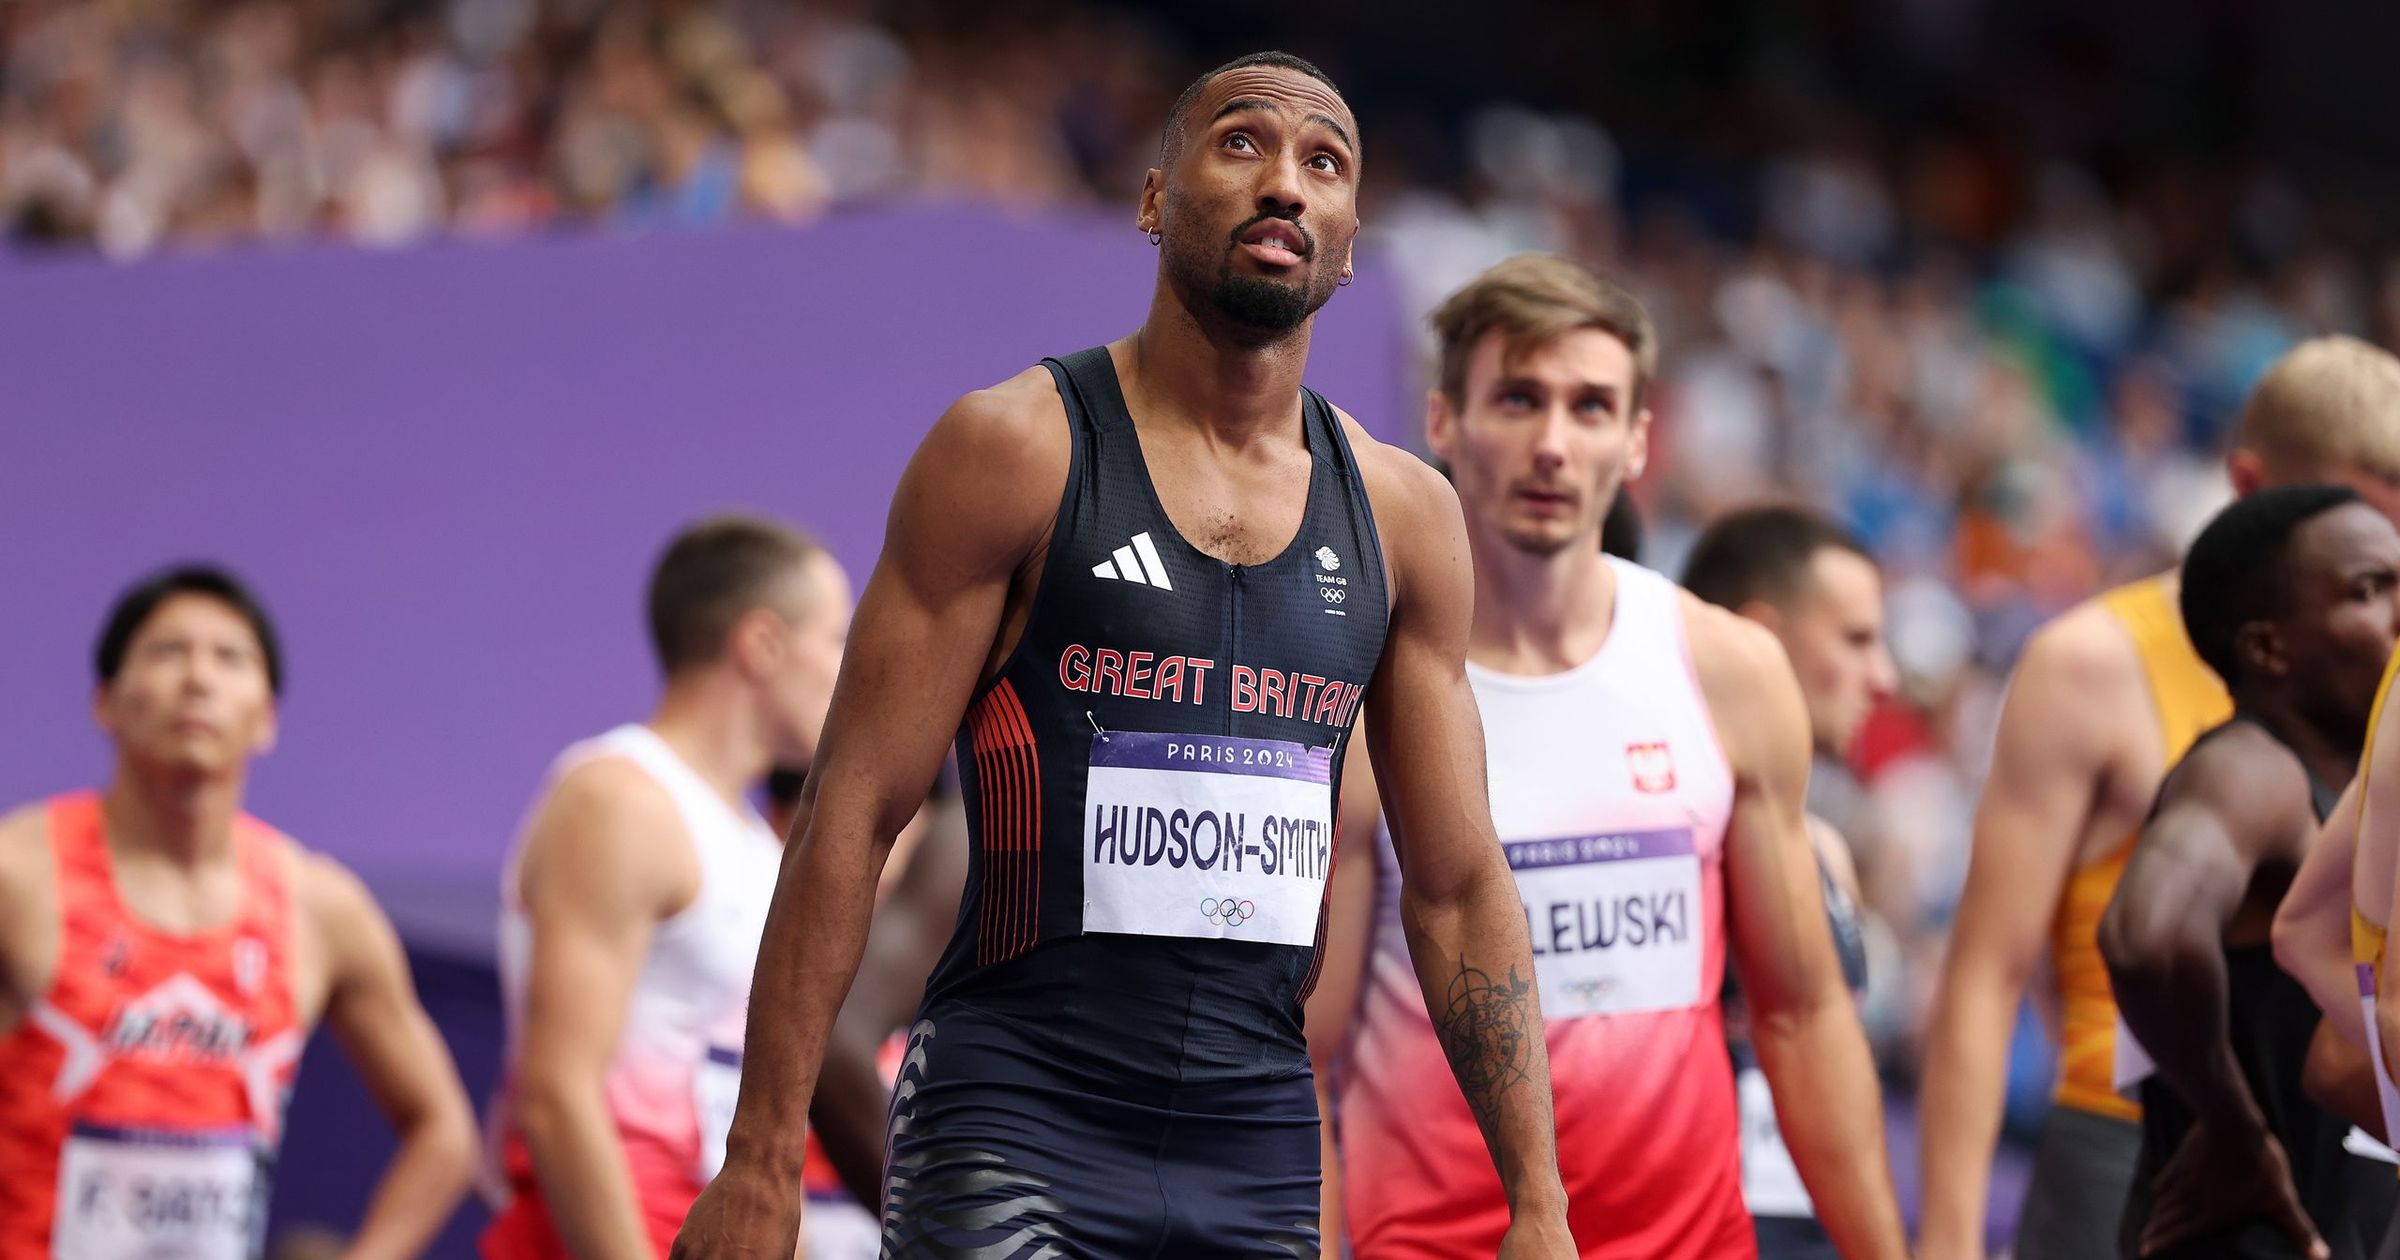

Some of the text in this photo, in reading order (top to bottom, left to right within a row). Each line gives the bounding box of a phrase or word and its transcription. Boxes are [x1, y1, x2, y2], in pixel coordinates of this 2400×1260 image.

[1315, 574, 1347, 586] TEAM GB
[1059, 644, 1365, 728] GREAT BRITAIN
[1243, 748, 1293, 768] 2024
[1094, 804, 1327, 881] HUDSON-SMITH
